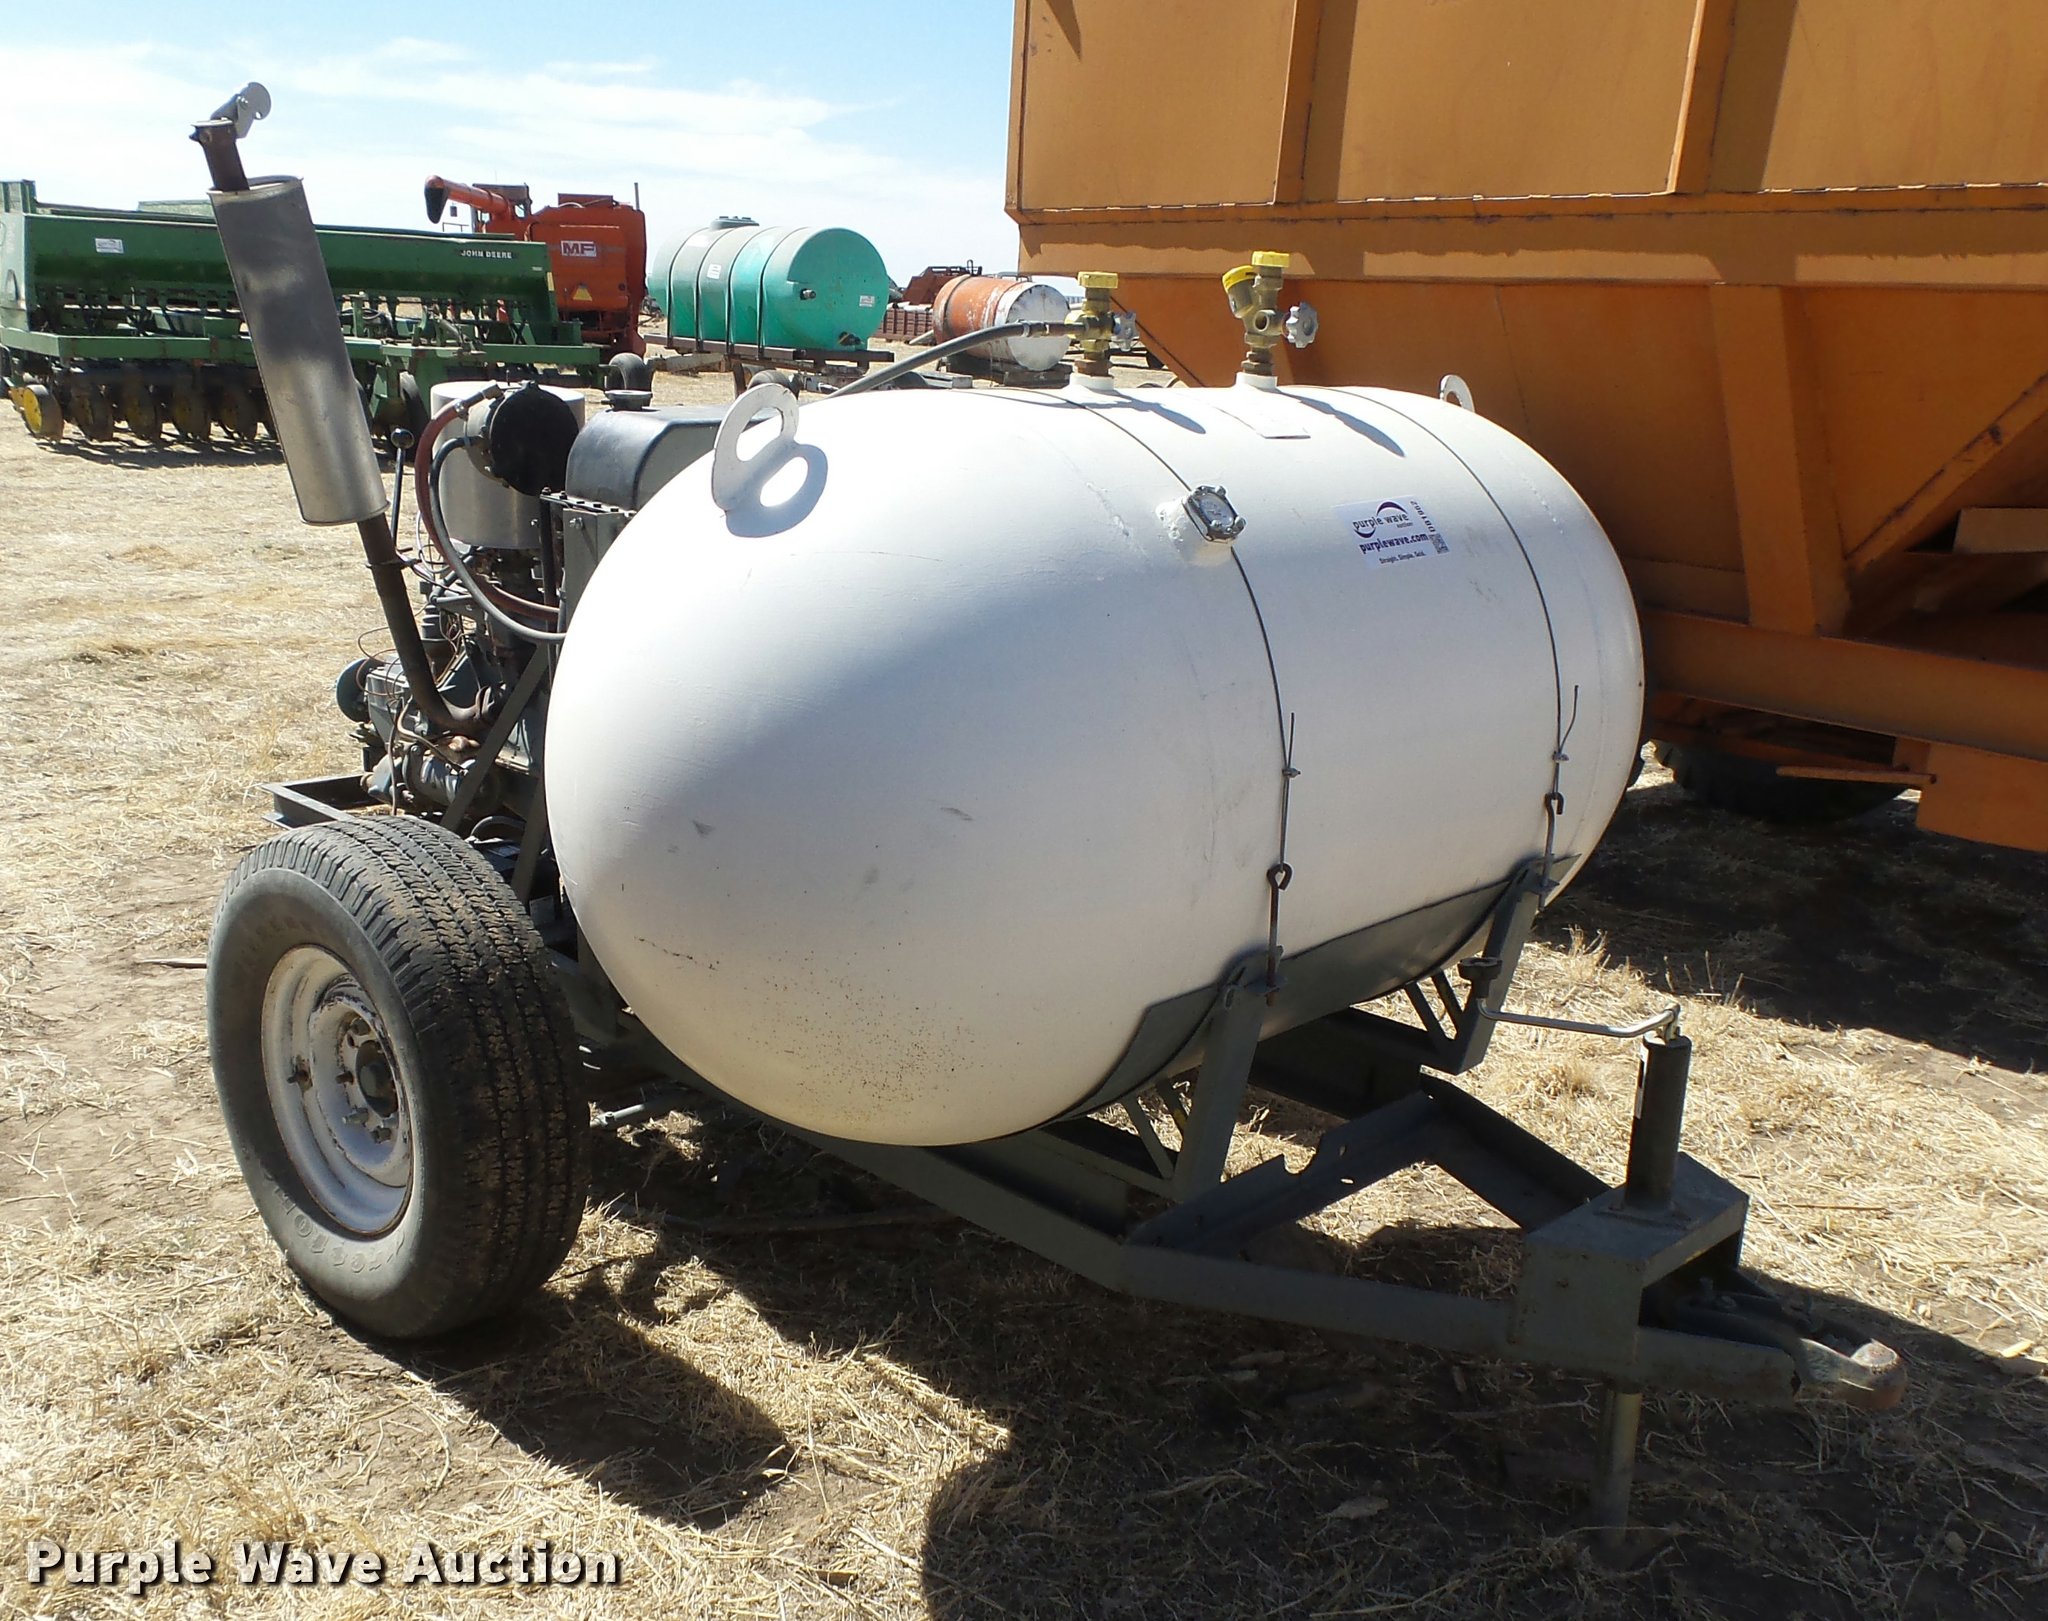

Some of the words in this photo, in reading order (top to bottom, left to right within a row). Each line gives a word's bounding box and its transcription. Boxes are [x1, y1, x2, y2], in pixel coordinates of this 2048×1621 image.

[461, 250, 484, 258] JOHN
[485, 251, 512, 259] DEERE
[562, 242, 595, 255] MF
[1353, 517, 1383, 530] purple
[1384, 514, 1409, 523] wave
[1359, 533, 1429, 554] purplewave.com
